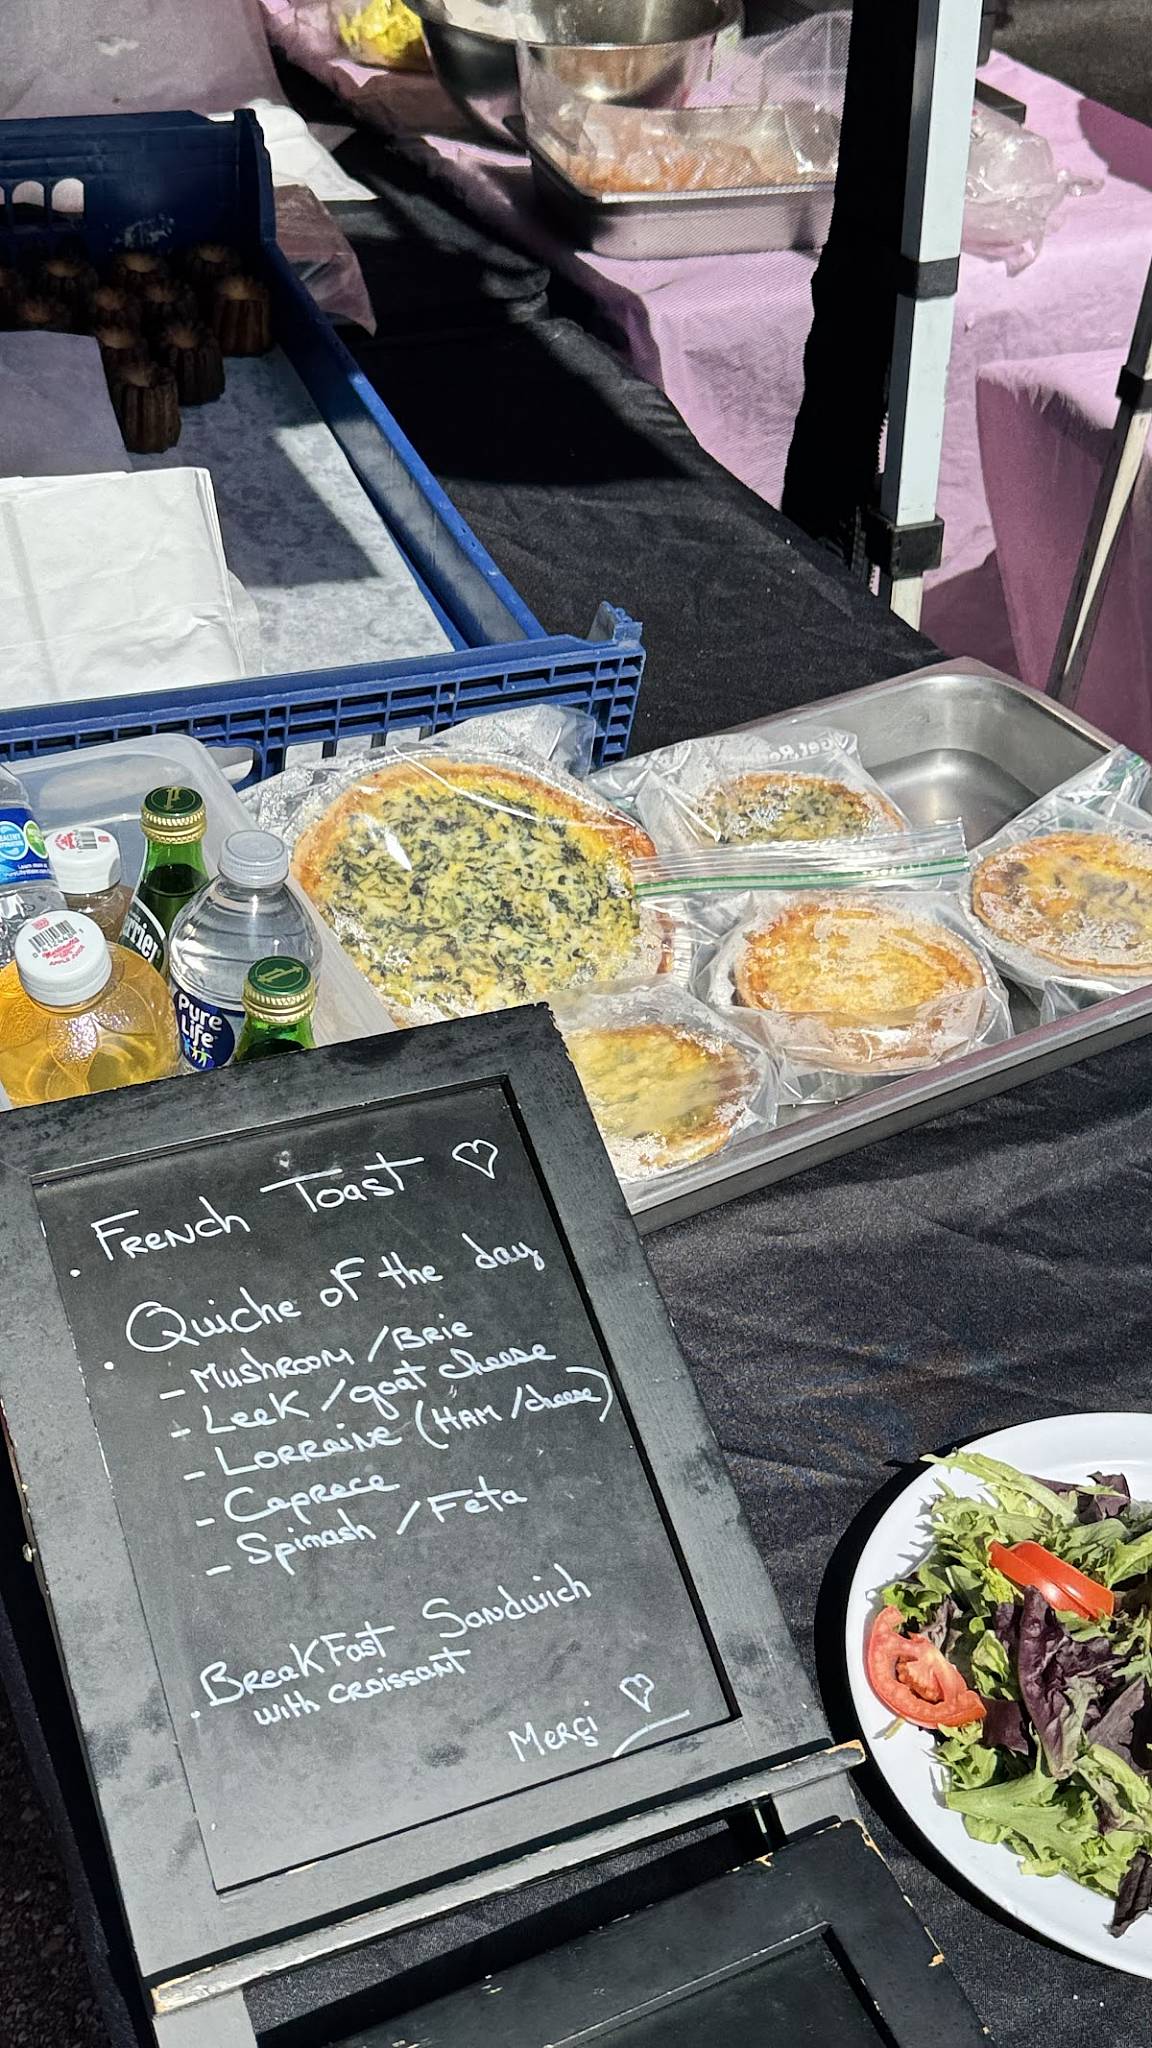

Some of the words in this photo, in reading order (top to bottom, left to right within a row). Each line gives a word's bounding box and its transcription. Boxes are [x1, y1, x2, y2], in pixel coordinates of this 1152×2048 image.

[178, 993, 223, 1031] Pure
[181, 1014, 214, 1049] Life
[260, 1151, 424, 1212] Toast
[126, 1287, 302, 1353] Quiche
[378, 1252, 443, 1289] the
[462, 1232, 545, 1271] day
[438, 1343, 557, 1379] cheese
[421, 1563, 593, 1639] Sandwich
[253, 1690, 321, 1725] with
[327, 1646, 472, 1704] croissant
